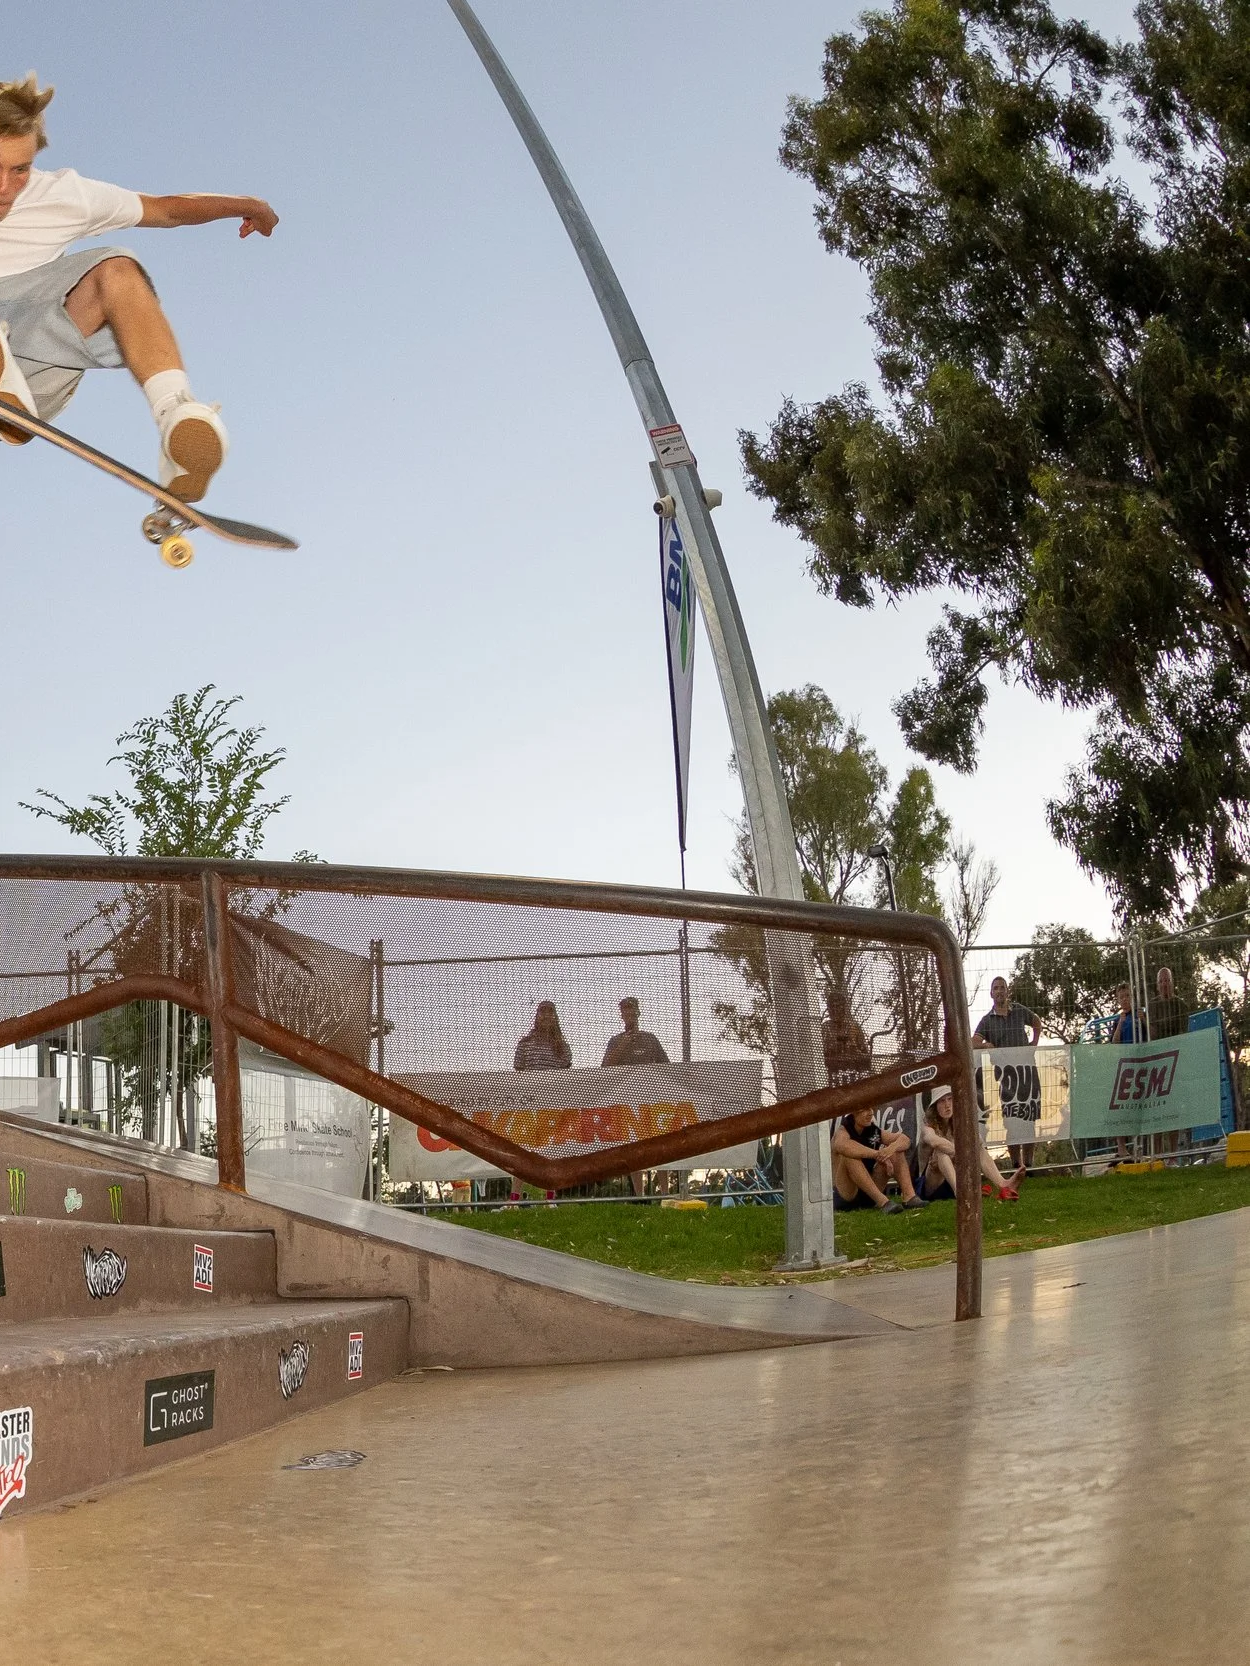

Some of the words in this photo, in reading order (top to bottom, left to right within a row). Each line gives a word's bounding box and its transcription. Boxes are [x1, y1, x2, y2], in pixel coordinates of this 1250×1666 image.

[1117, 1064, 1170, 1101] ESM
[312, 1122, 332, 1135] Skate
[332, 1125, 353, 1138] School
[195, 1252, 212, 1271] MV2
[194, 1268, 212, 1285] ADL
[171, 1406, 204, 1427] RACKS
